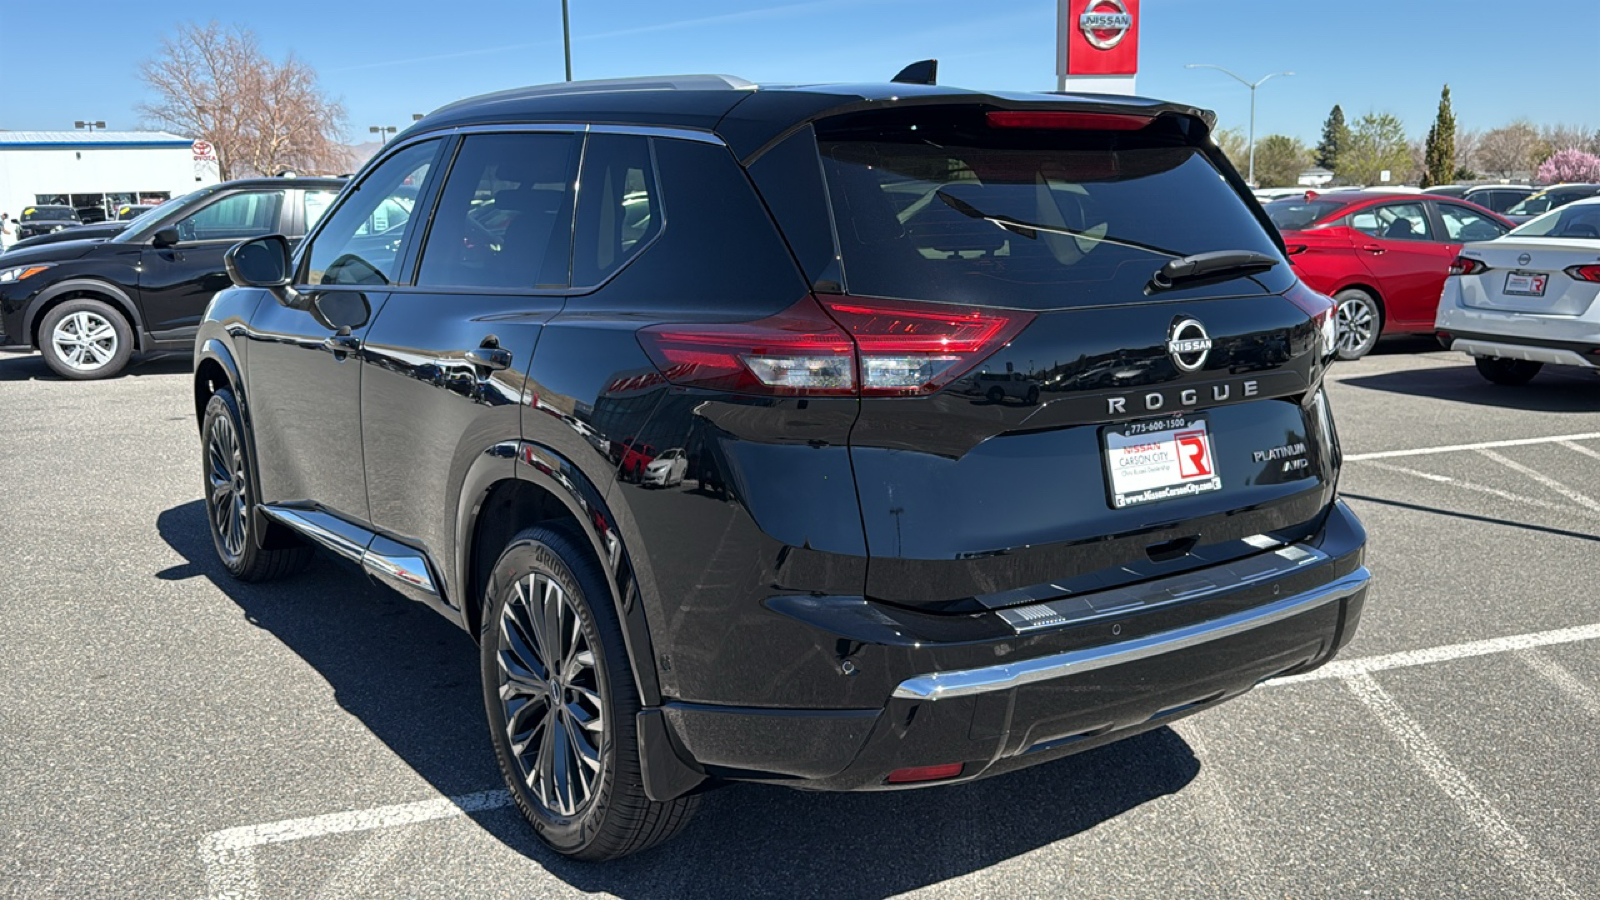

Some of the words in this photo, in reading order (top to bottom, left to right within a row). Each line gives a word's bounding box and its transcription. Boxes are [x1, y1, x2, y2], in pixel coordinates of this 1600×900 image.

[1085, 15, 1129, 26] NISSAN
[1169, 338, 1212, 353] NISSAN
[1107, 380, 1259, 415] ROGUE
[1131, 418, 1185, 434] 775-600-1500
[1123, 442, 1161, 455] NISSAN
[1252, 442, 1307, 463] PLATINUM
[1119, 453, 1151, 467] CARSON
[1151, 451, 1169, 462] CITY
[1281, 458, 1309, 472] AWD
